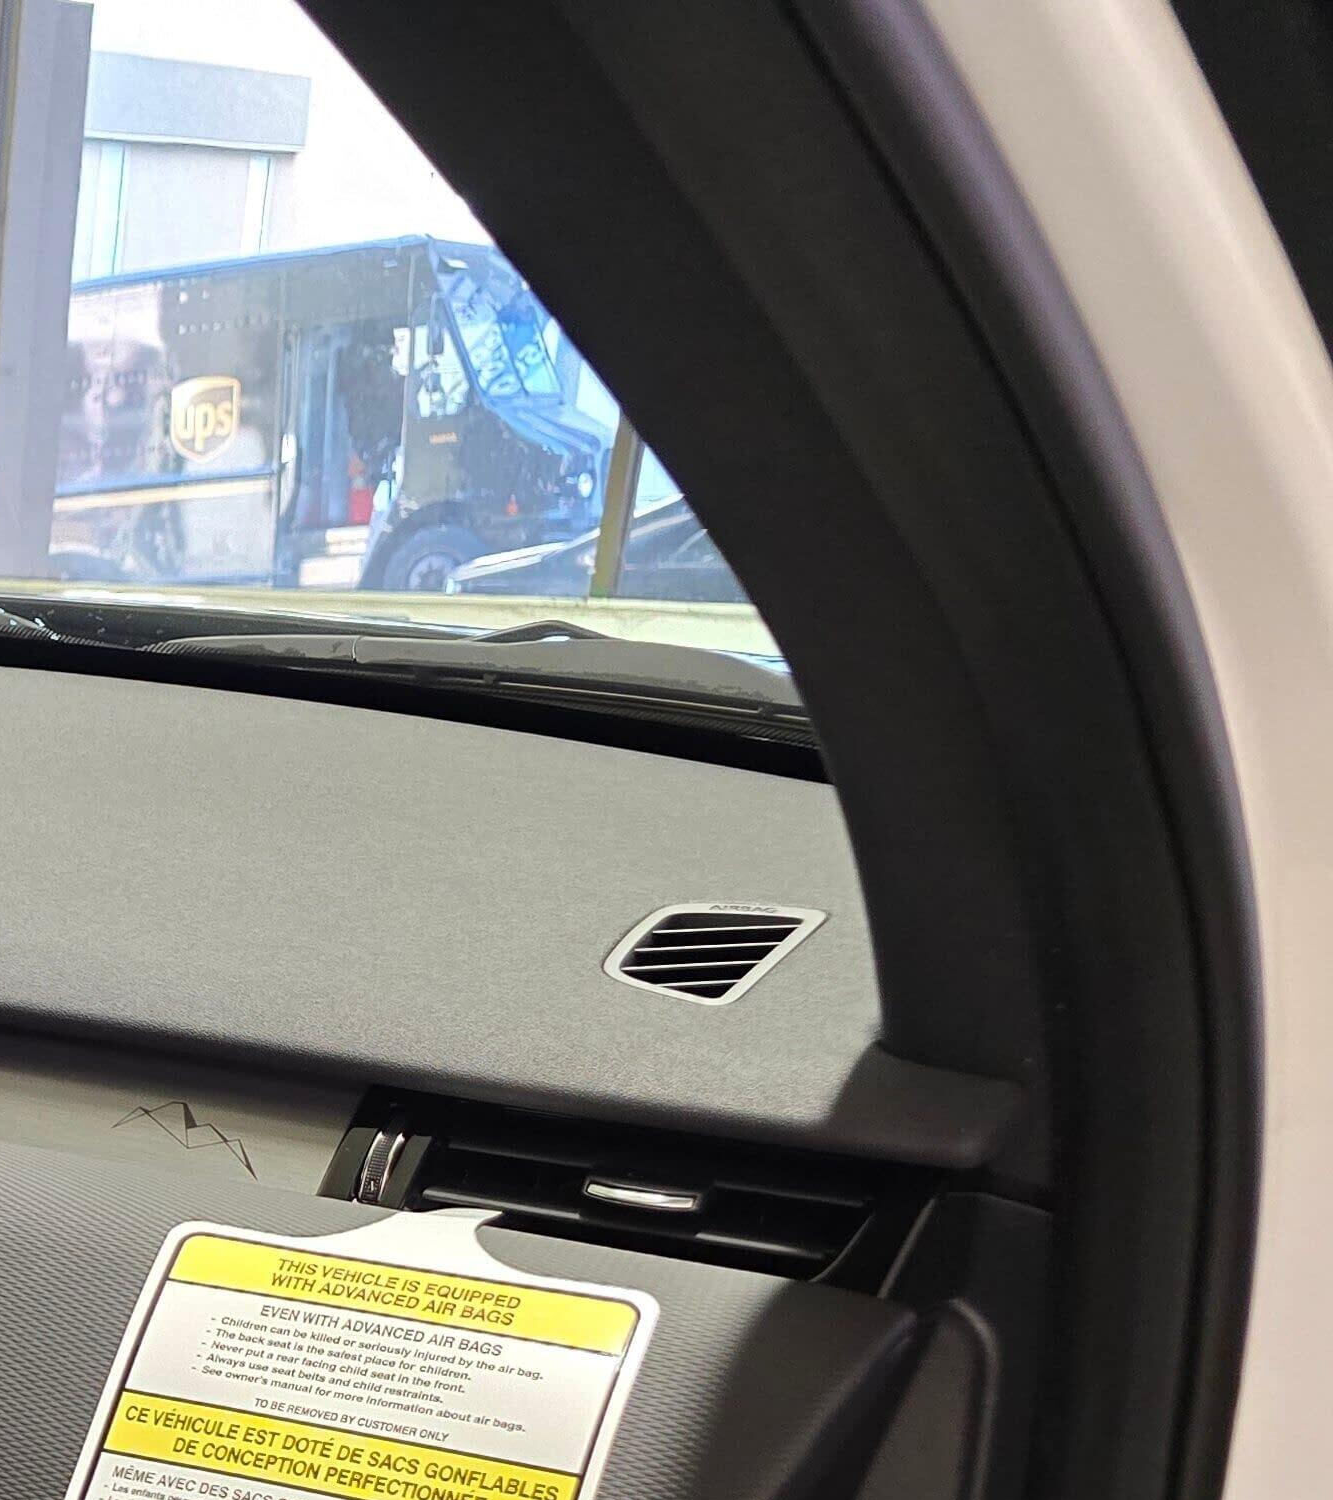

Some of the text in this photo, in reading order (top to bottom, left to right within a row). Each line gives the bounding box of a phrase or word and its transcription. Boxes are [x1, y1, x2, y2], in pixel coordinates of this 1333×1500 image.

[173, 400, 233, 451] ups
[708, 903, 778, 914] AIRBAG
[271, 1273, 515, 1326] WITH ADVANCED AIR BAGS
[279, 1258, 521, 1309] THIS VEHICLE IS EQUIPPED
[216, 1328, 471, 1381] The back seat is the safest place for children.
[221, 1316, 543, 1381] Children can be killed or seriously injured by the air bag.
[260, 1305, 503, 1356] EVEN WITH ADVANCED AIR BAGS
[206, 1353, 246, 1368] Always
[248, 1362, 269, 1372] use
[271, 1367, 296, 1377] seat
[328, 1377, 351, 1387] and
[353, 1381, 383, 1393] child
[384, 1387, 443, 1404] restraints.
[211, 1340, 244, 1354] Never
[244, 1349, 265, 1358] put
[276, 1354, 300, 1364] rear
[301, 1357, 337, 1373] facing
[339, 1365, 369, 1377] child
[370, 1371, 396, 1382] seat
[397, 1373, 409, 1384] in
[412, 1377, 431, 1387] the
[434, 1380, 465, 1393] front.
[201, 1365, 525, 1432] See owner's manual for more information about air bags.
[255, 1397, 449, 1442] TO BE REMOVED BY CUSTOMER ONLY
[125, 1405, 151, 1424] CE
[154, 1408, 241, 1440] VÉHICULE
[242, 1426, 281, 1447] EST
[281, 1434, 335, 1459] DOTÉ
[336, 1445, 365, 1465] DE
[367, 1451, 420, 1475] SACS
[172, 1437, 200, 1456] DE
[202, 1442, 322, 1480] CONCEPTION
[112, 1465, 156, 1484] MÊME
[156, 1475, 197, 1492] AVEC
[198, 1482, 229, 1499] DES
